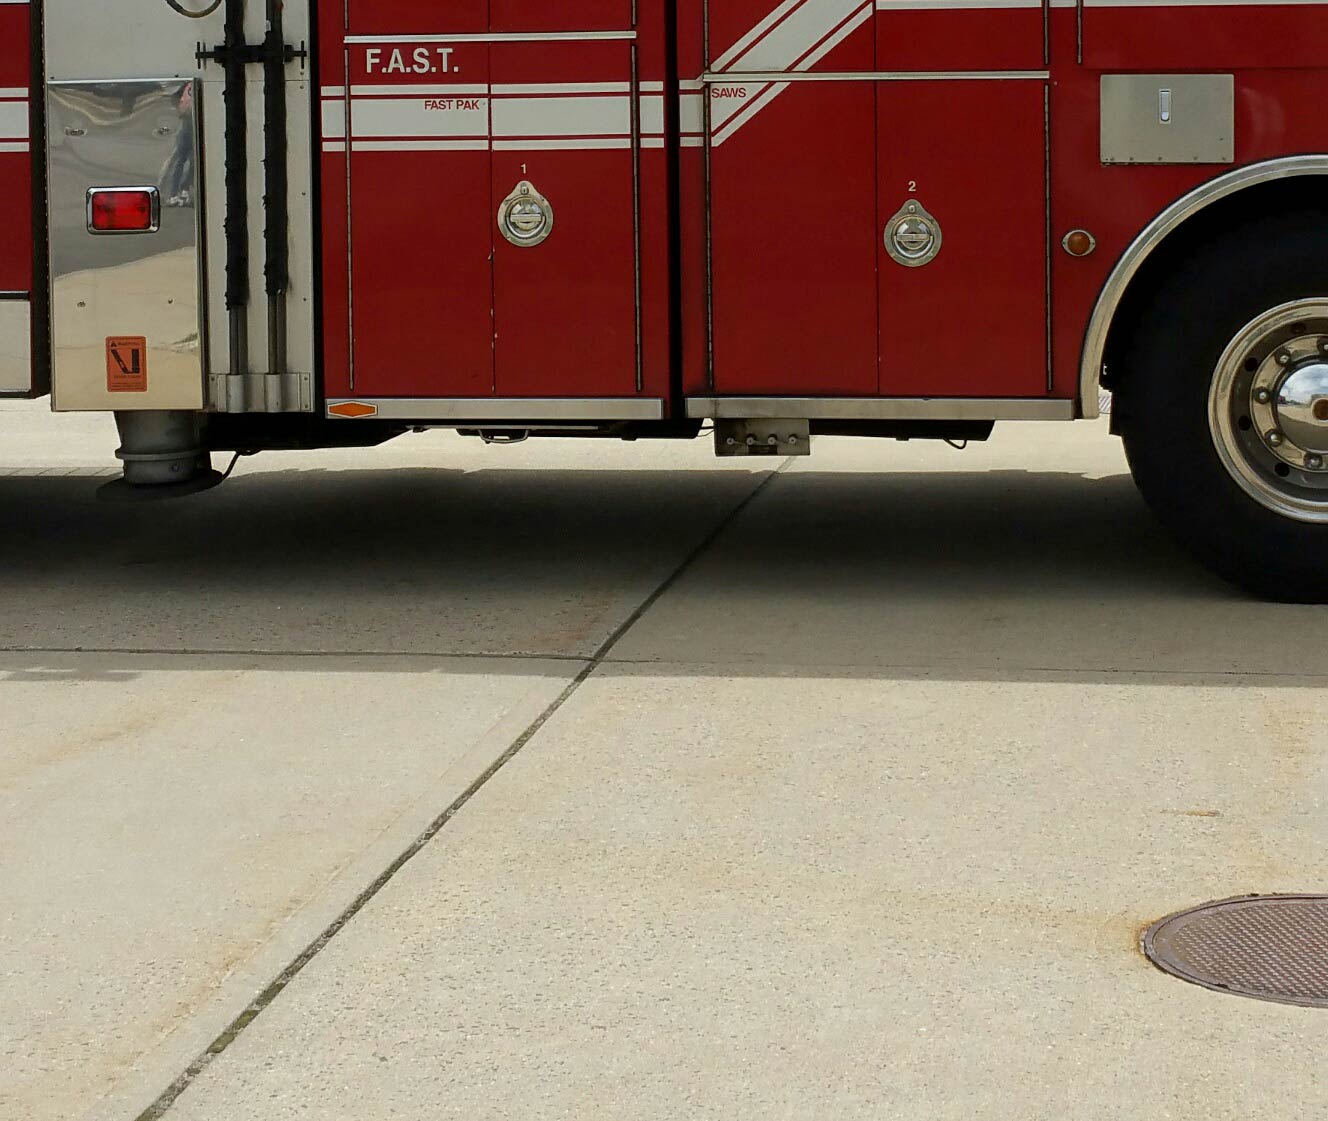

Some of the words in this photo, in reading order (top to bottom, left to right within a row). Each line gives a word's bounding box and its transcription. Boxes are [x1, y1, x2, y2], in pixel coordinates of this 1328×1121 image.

[365, 47, 460, 74] F.A.S.T.
[711, 87, 747, 99] SAWS
[424, 99, 454, 111] FAST
[456, 99, 480, 111] PAK
[520, 163, 527, 175] 1
[908, 180, 917, 192] 2
